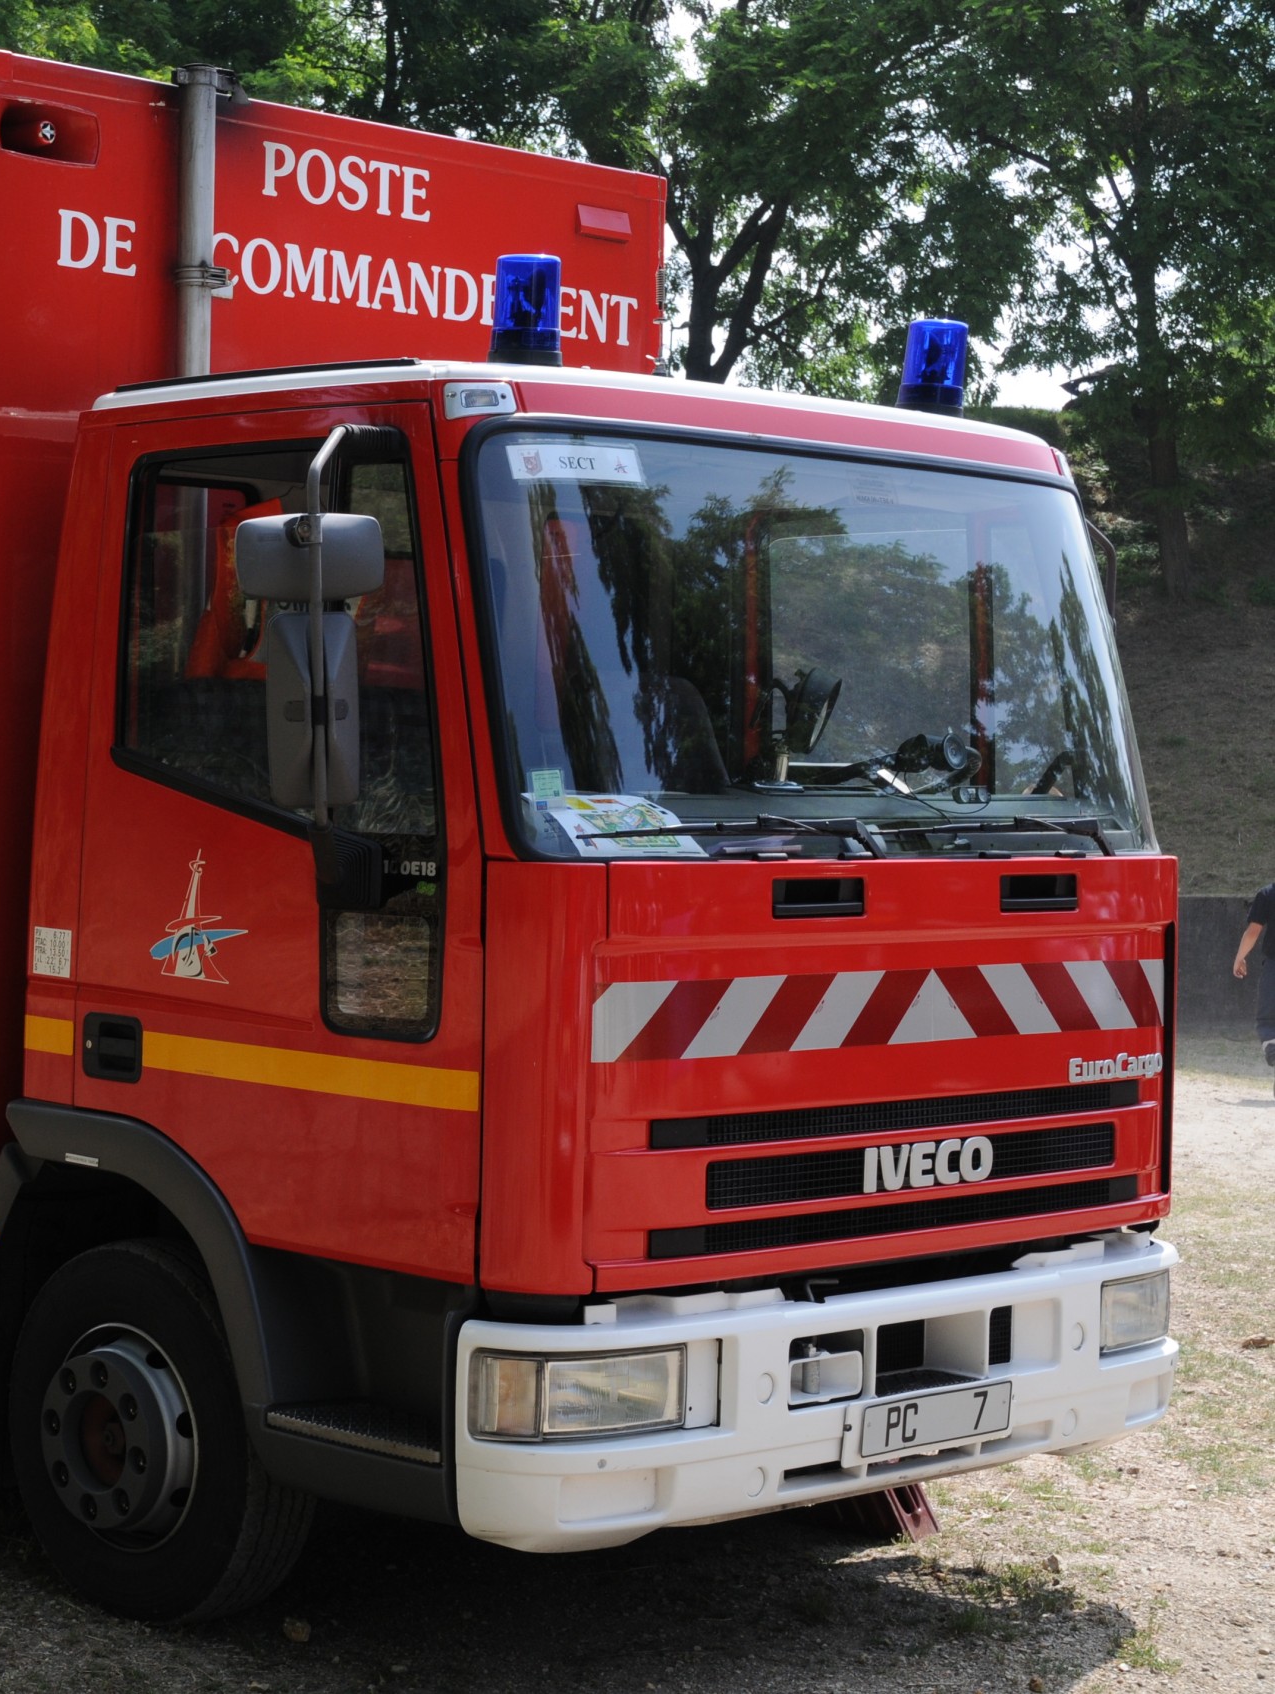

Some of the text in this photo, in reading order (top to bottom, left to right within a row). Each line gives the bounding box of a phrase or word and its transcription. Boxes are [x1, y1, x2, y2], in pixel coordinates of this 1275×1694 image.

[262, 140, 431, 222] POSTE
[56, 208, 638, 346] DE COMMANDEENT
[558, 456, 595, 471] SECT
[1068, 1051, 1163, 1084] EuroCargo
[863, 1135, 994, 1194] IVECO
[885, 1390, 989, 1447] PC 7
